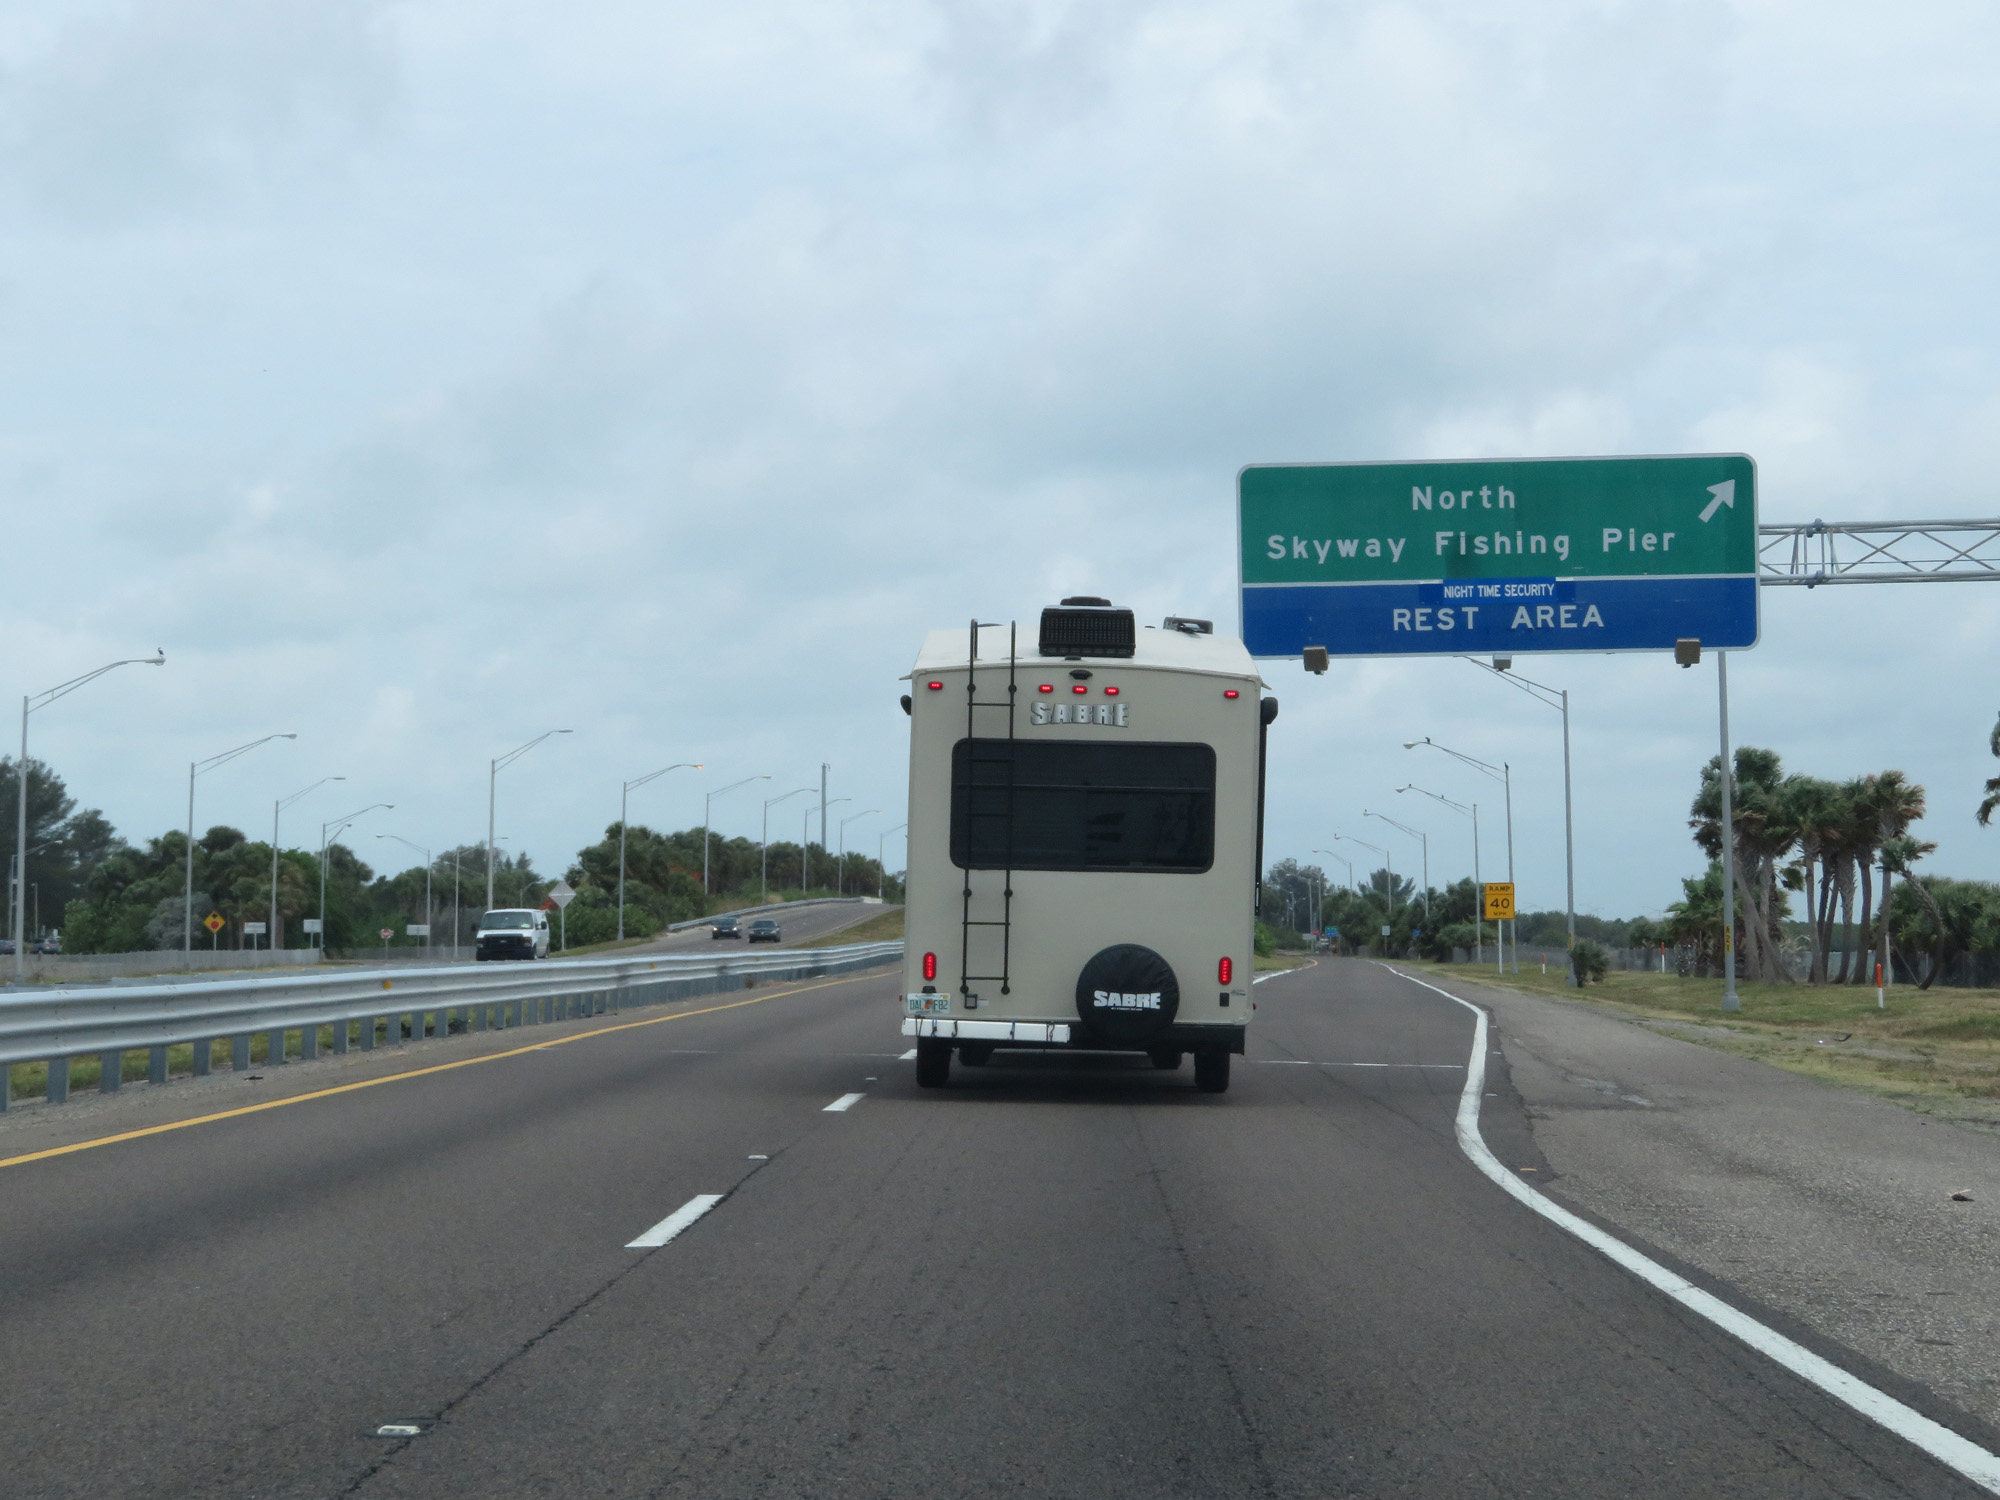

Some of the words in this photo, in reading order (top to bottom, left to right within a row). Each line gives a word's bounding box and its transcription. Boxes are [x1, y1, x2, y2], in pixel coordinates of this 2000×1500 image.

[1412, 486, 1516, 511] North
[1266, 534, 1407, 564] Skyway
[1435, 530, 1571, 561] Fishing
[1602, 527, 1676, 553] Pier
[1444, 585, 1474, 598] NIGHT
[1478, 584, 1501, 597] TIME
[1504, 583, 1555, 597] SECURITY
[1392, 606, 1479, 631] REST
[1511, 604, 1605, 630] AREA
[1031, 701, 1129, 728] SABRE
[1490, 897, 1510, 909] 40
[1093, 990, 1161, 1010] SABRE
